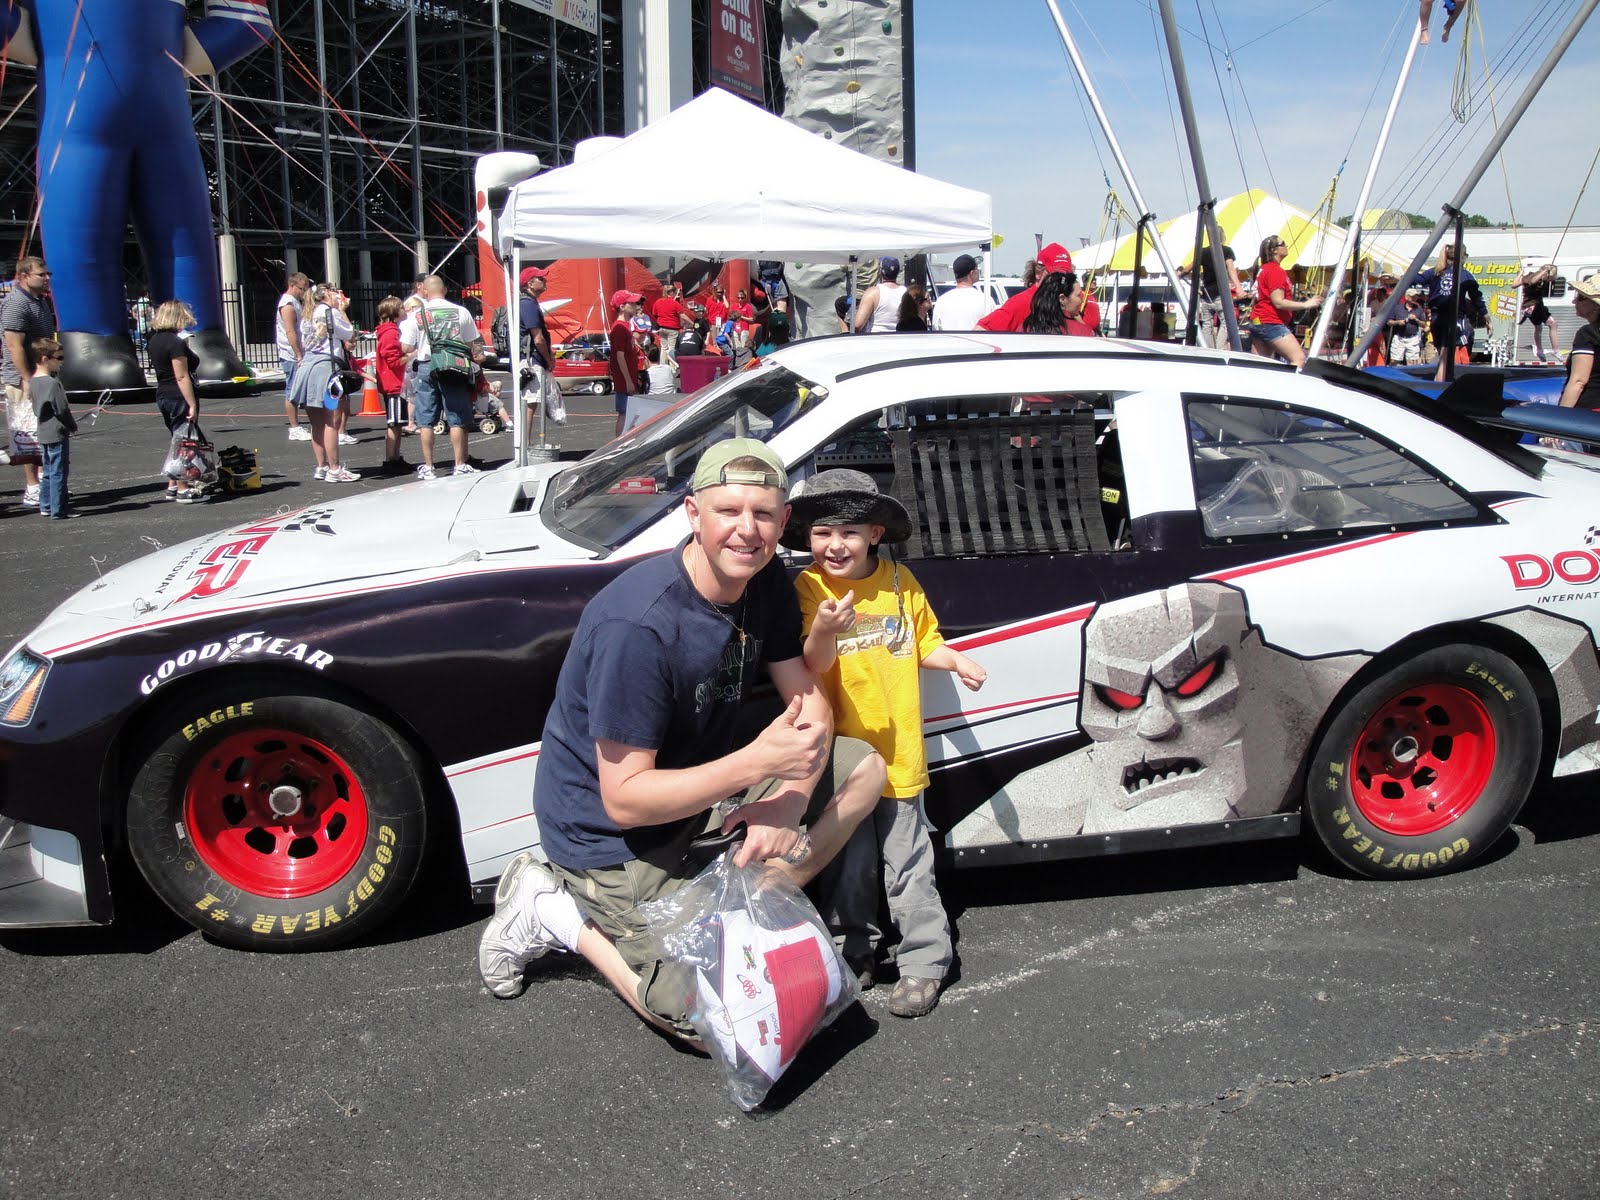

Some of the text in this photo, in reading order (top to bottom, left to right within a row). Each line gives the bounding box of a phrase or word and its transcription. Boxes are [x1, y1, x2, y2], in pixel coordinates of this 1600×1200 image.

[721, 10, 755, 44] on us.
[1498, 548, 1600, 592] DO
[140, 631, 334, 695] GOODYEAR
[181, 702, 254, 742] EAGLE
[1325, 762, 1345, 792] #1
[195, 892, 230, 922] #1
